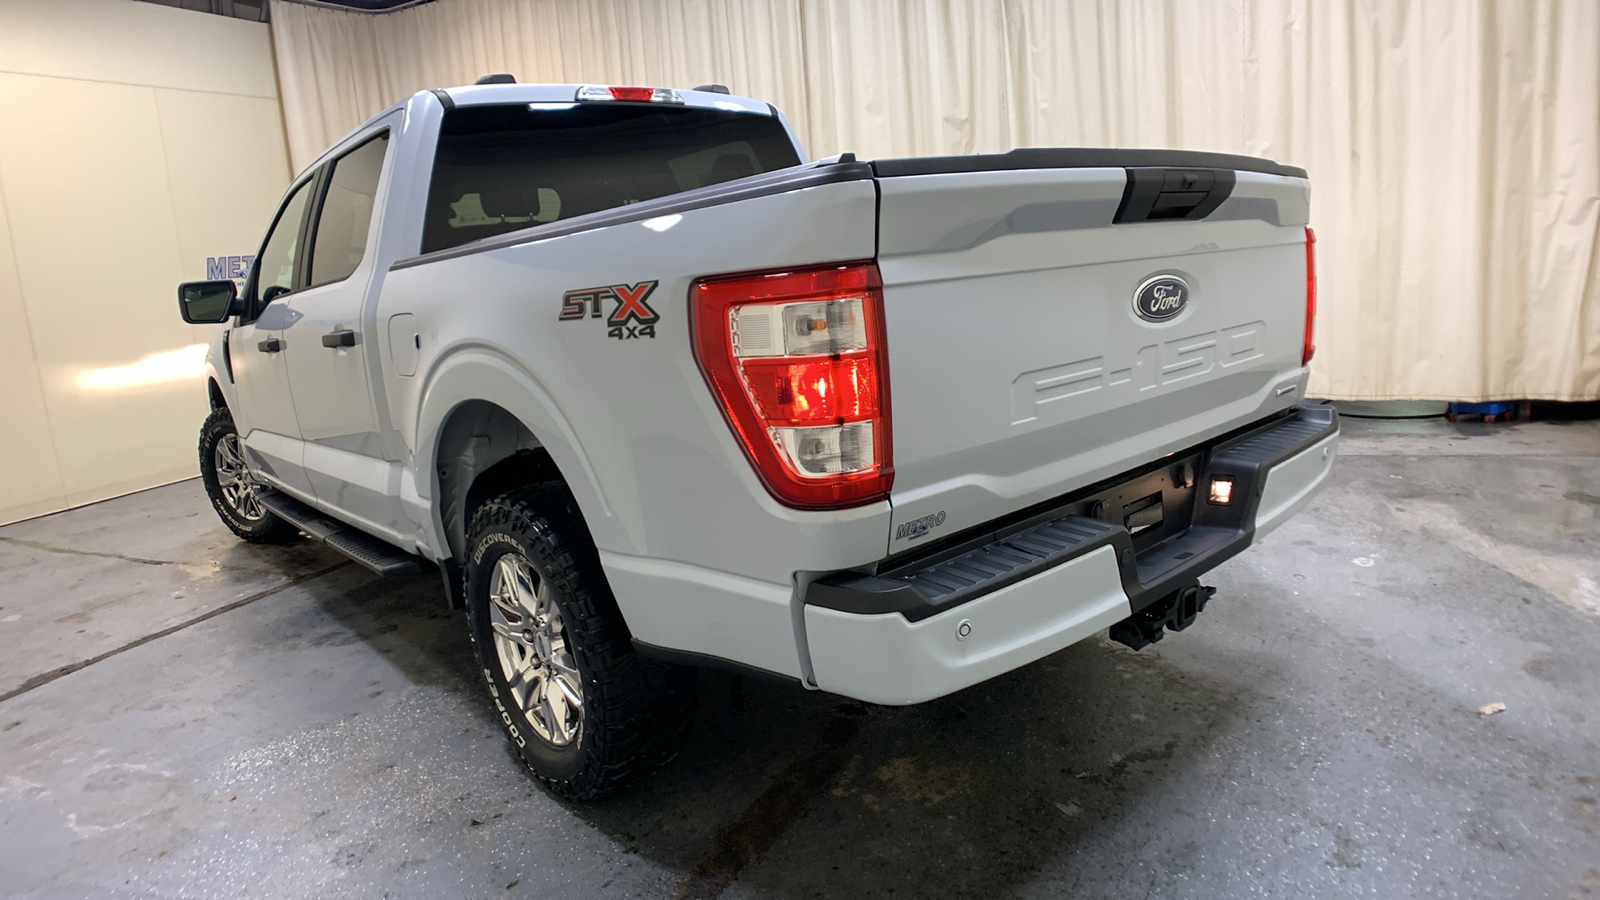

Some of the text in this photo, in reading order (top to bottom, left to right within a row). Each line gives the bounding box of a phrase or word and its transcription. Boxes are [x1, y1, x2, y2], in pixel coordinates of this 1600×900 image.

[559, 279, 660, 327] STX
[1150, 285, 1182, 312] Ford
[1011, 319, 1267, 426] F-150
[896, 510, 947, 541] METRO
[474, 532, 526, 566] DISCOVERER
[483, 668, 526, 749] COOPER
